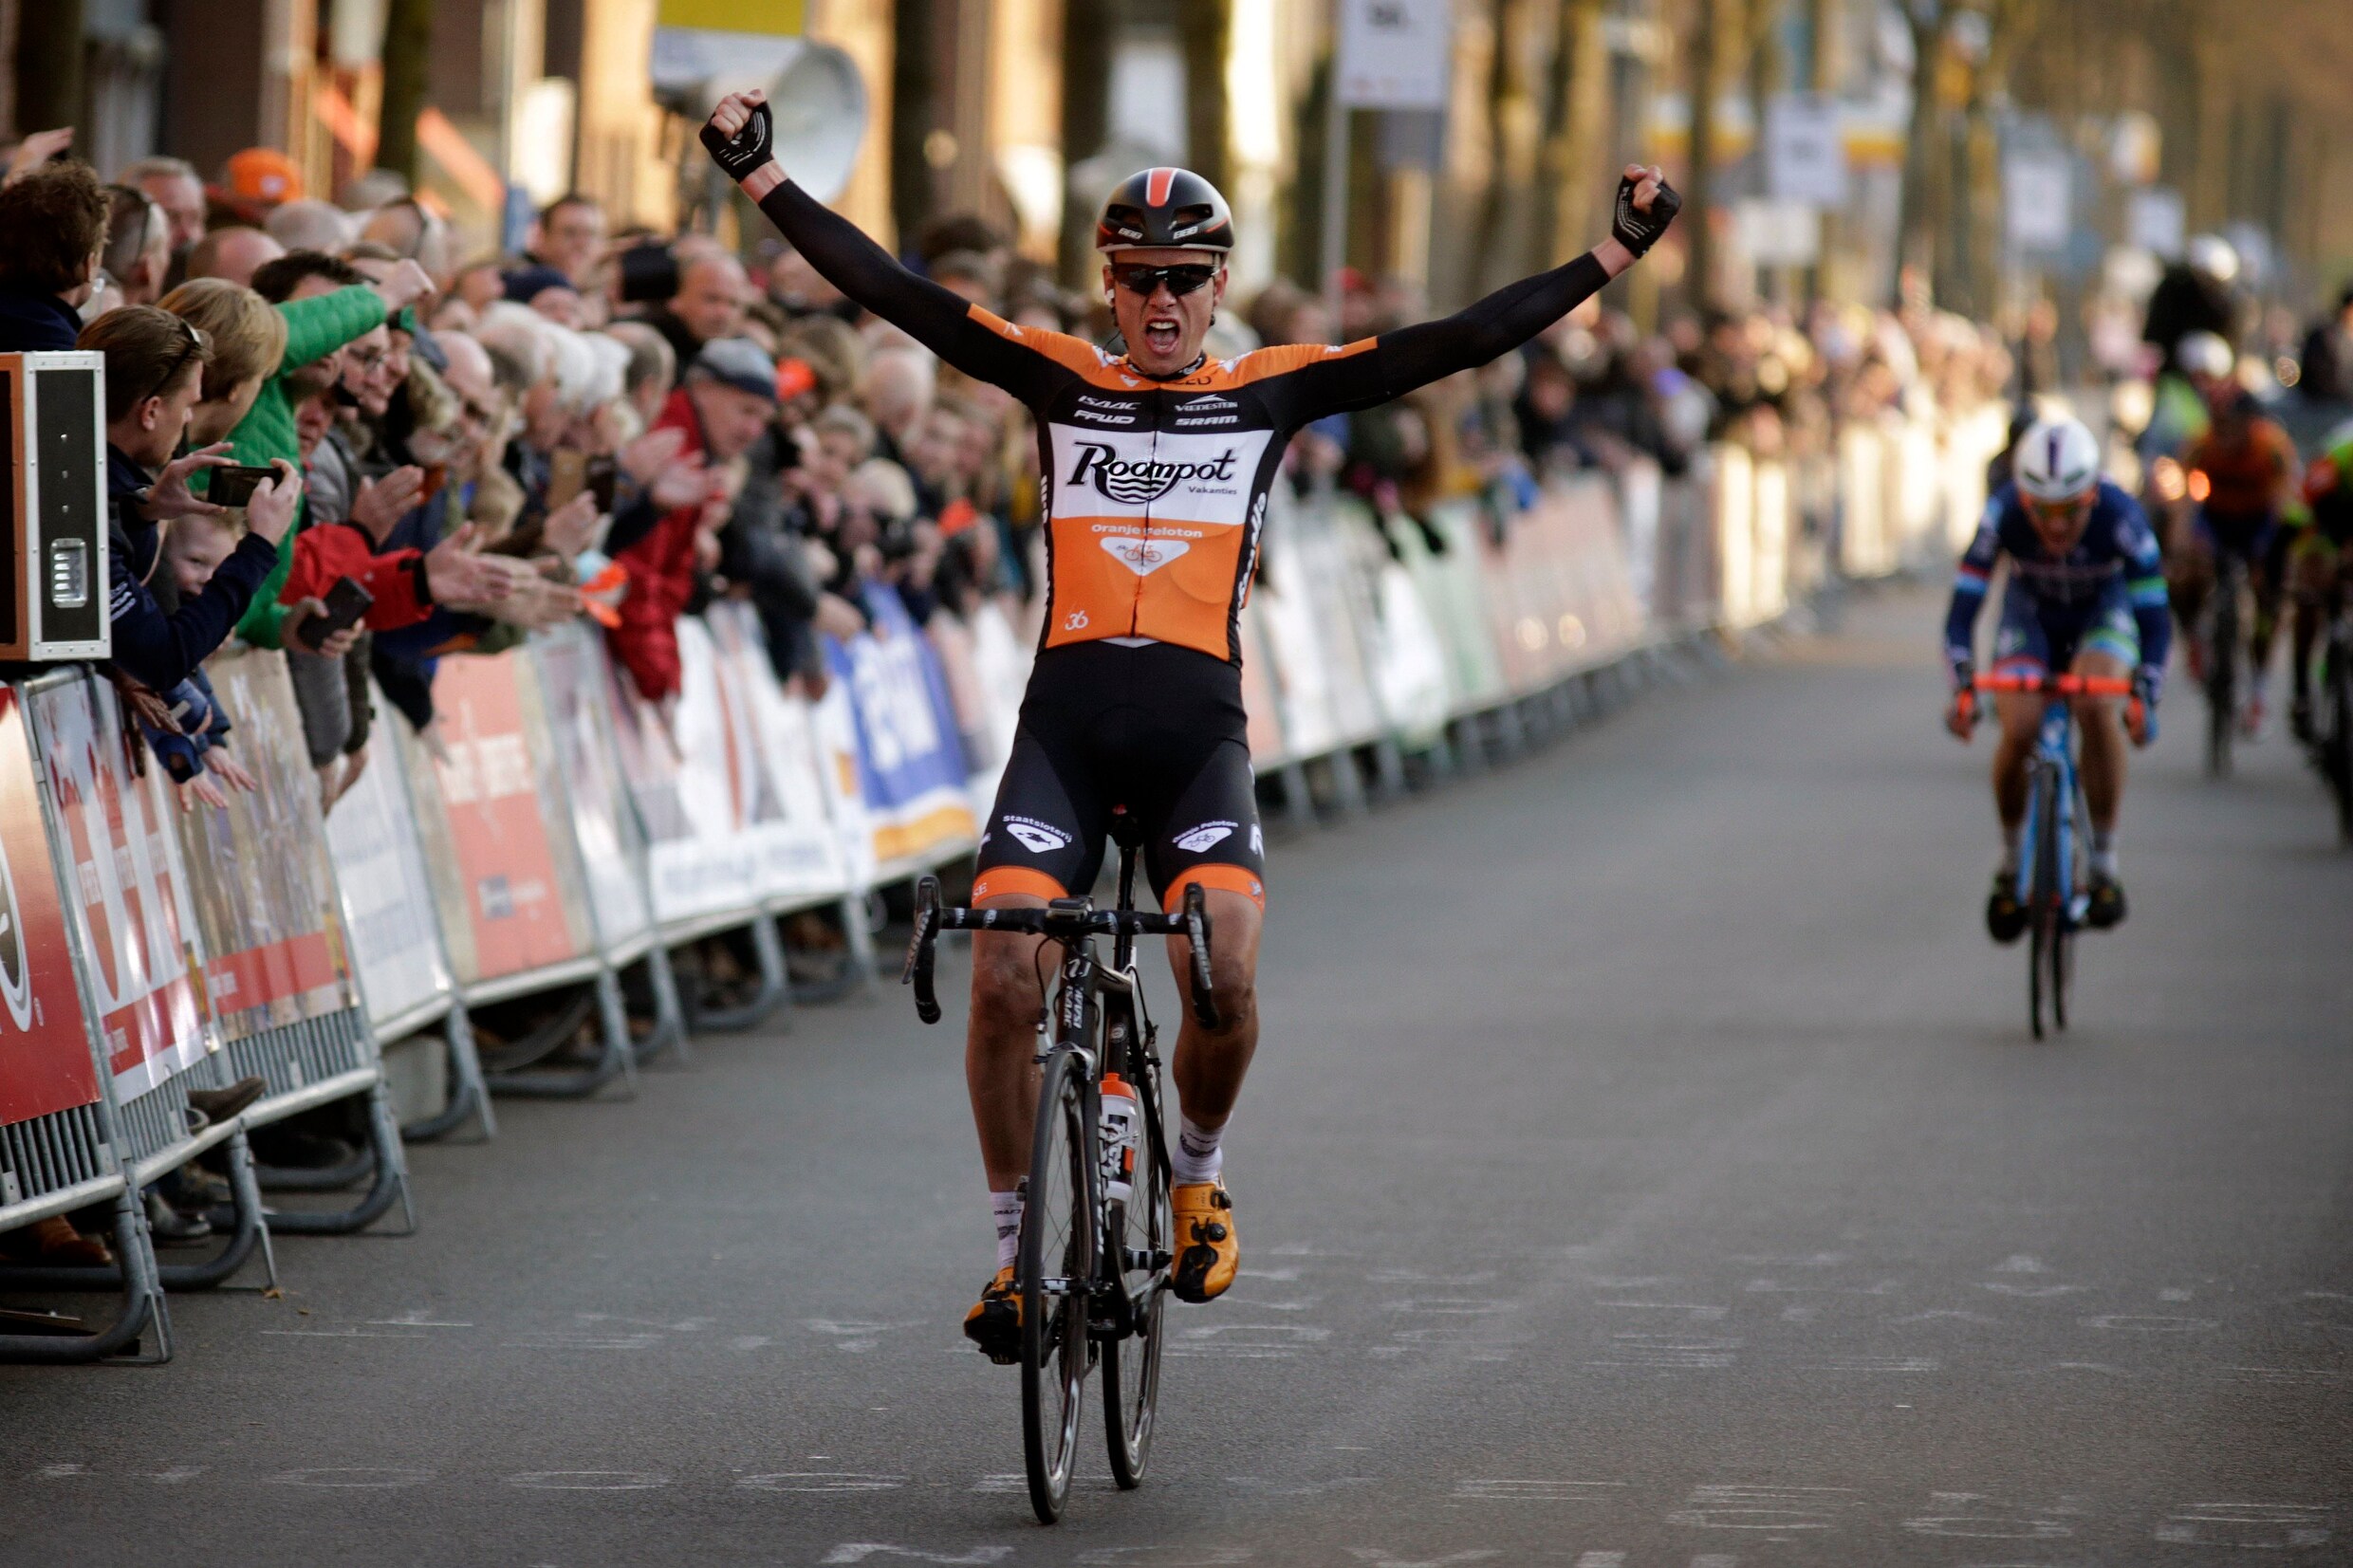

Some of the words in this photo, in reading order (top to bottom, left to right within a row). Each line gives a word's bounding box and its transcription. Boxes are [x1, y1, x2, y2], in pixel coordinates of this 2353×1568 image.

[1078, 395, 1141, 411] ISAAC
[1074, 409, 1136, 425] FFWD
[1175, 415, 1238, 426] SRAM
[1066, 441, 1236, 505] Roompot
[1188, 486, 1237, 495] Vakanties
[1065, 610, 1089, 631] 36
